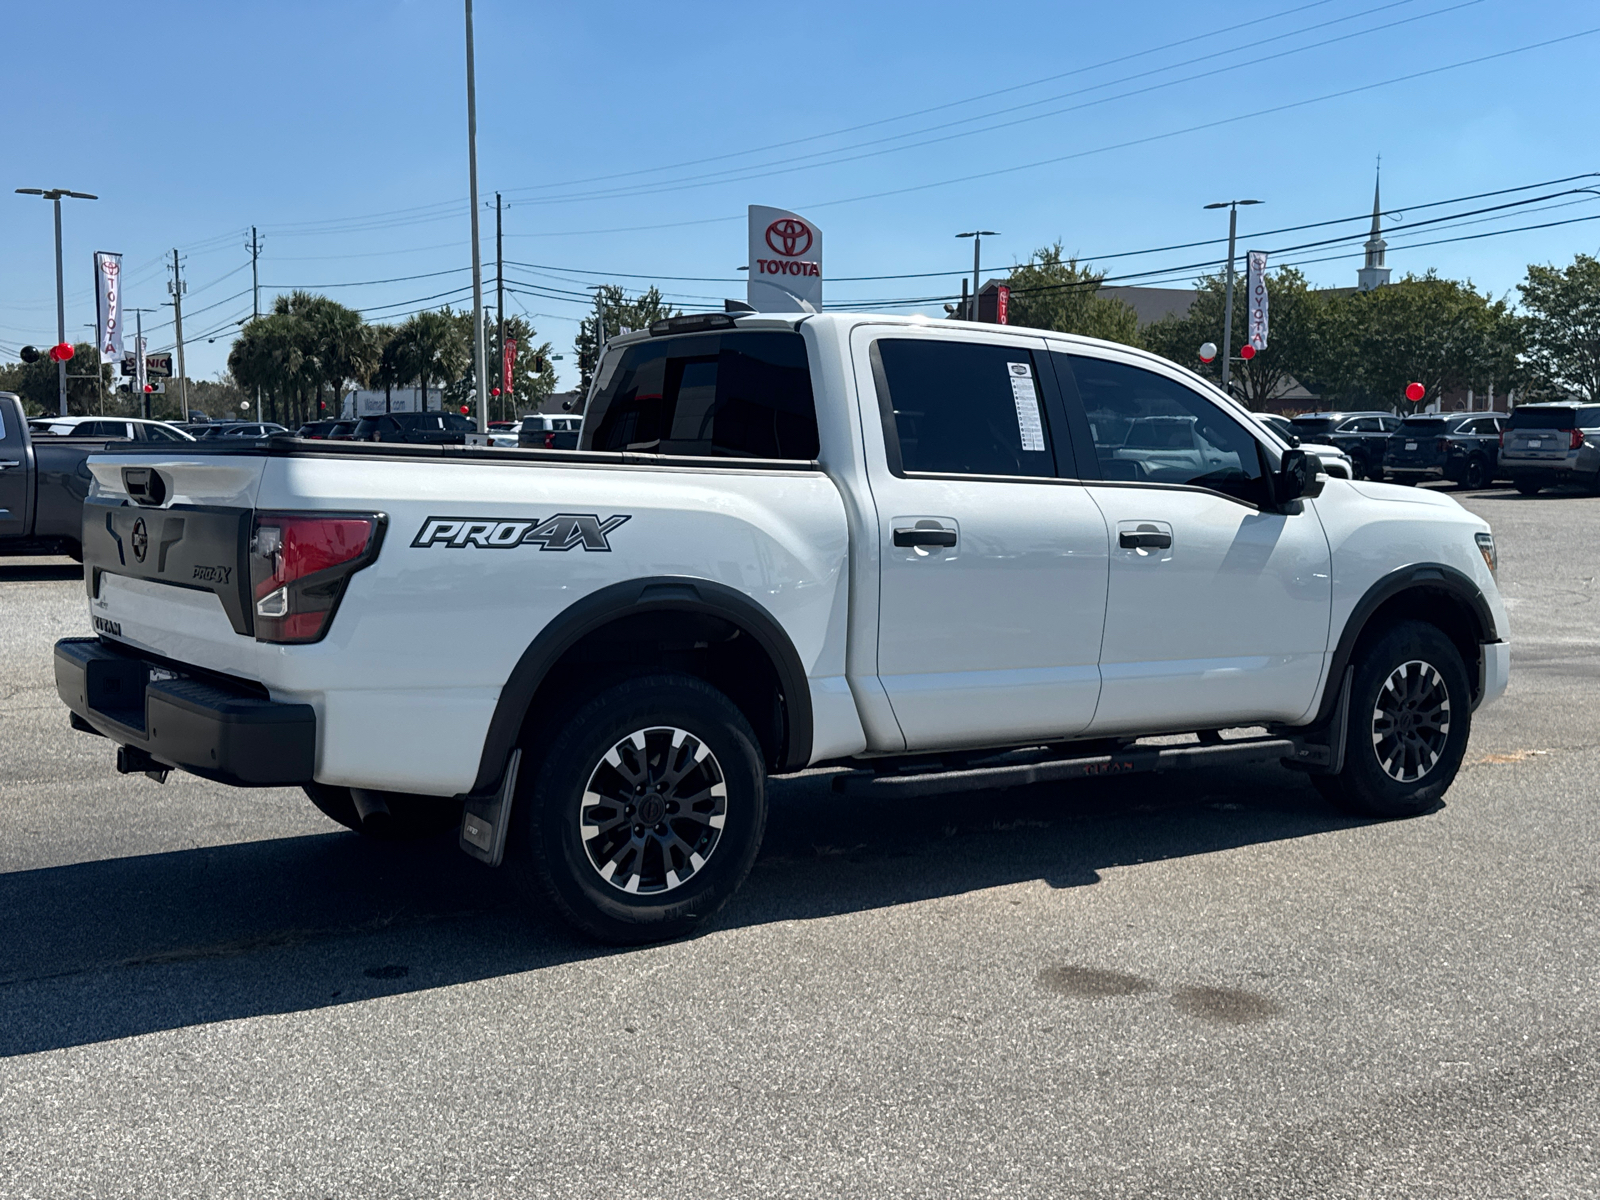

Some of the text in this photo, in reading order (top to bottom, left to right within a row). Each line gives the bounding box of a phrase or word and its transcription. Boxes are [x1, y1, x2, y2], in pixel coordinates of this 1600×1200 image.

[757, 259, 820, 277] TOYOTA
[104, 278, 116, 355] TOYOTA
[1253, 273, 1264, 343] TOYOTA
[126, 357, 168, 368] SNIC
[93, 615, 122, 637] TITAN
[1083, 761, 1134, 775] TITAN
